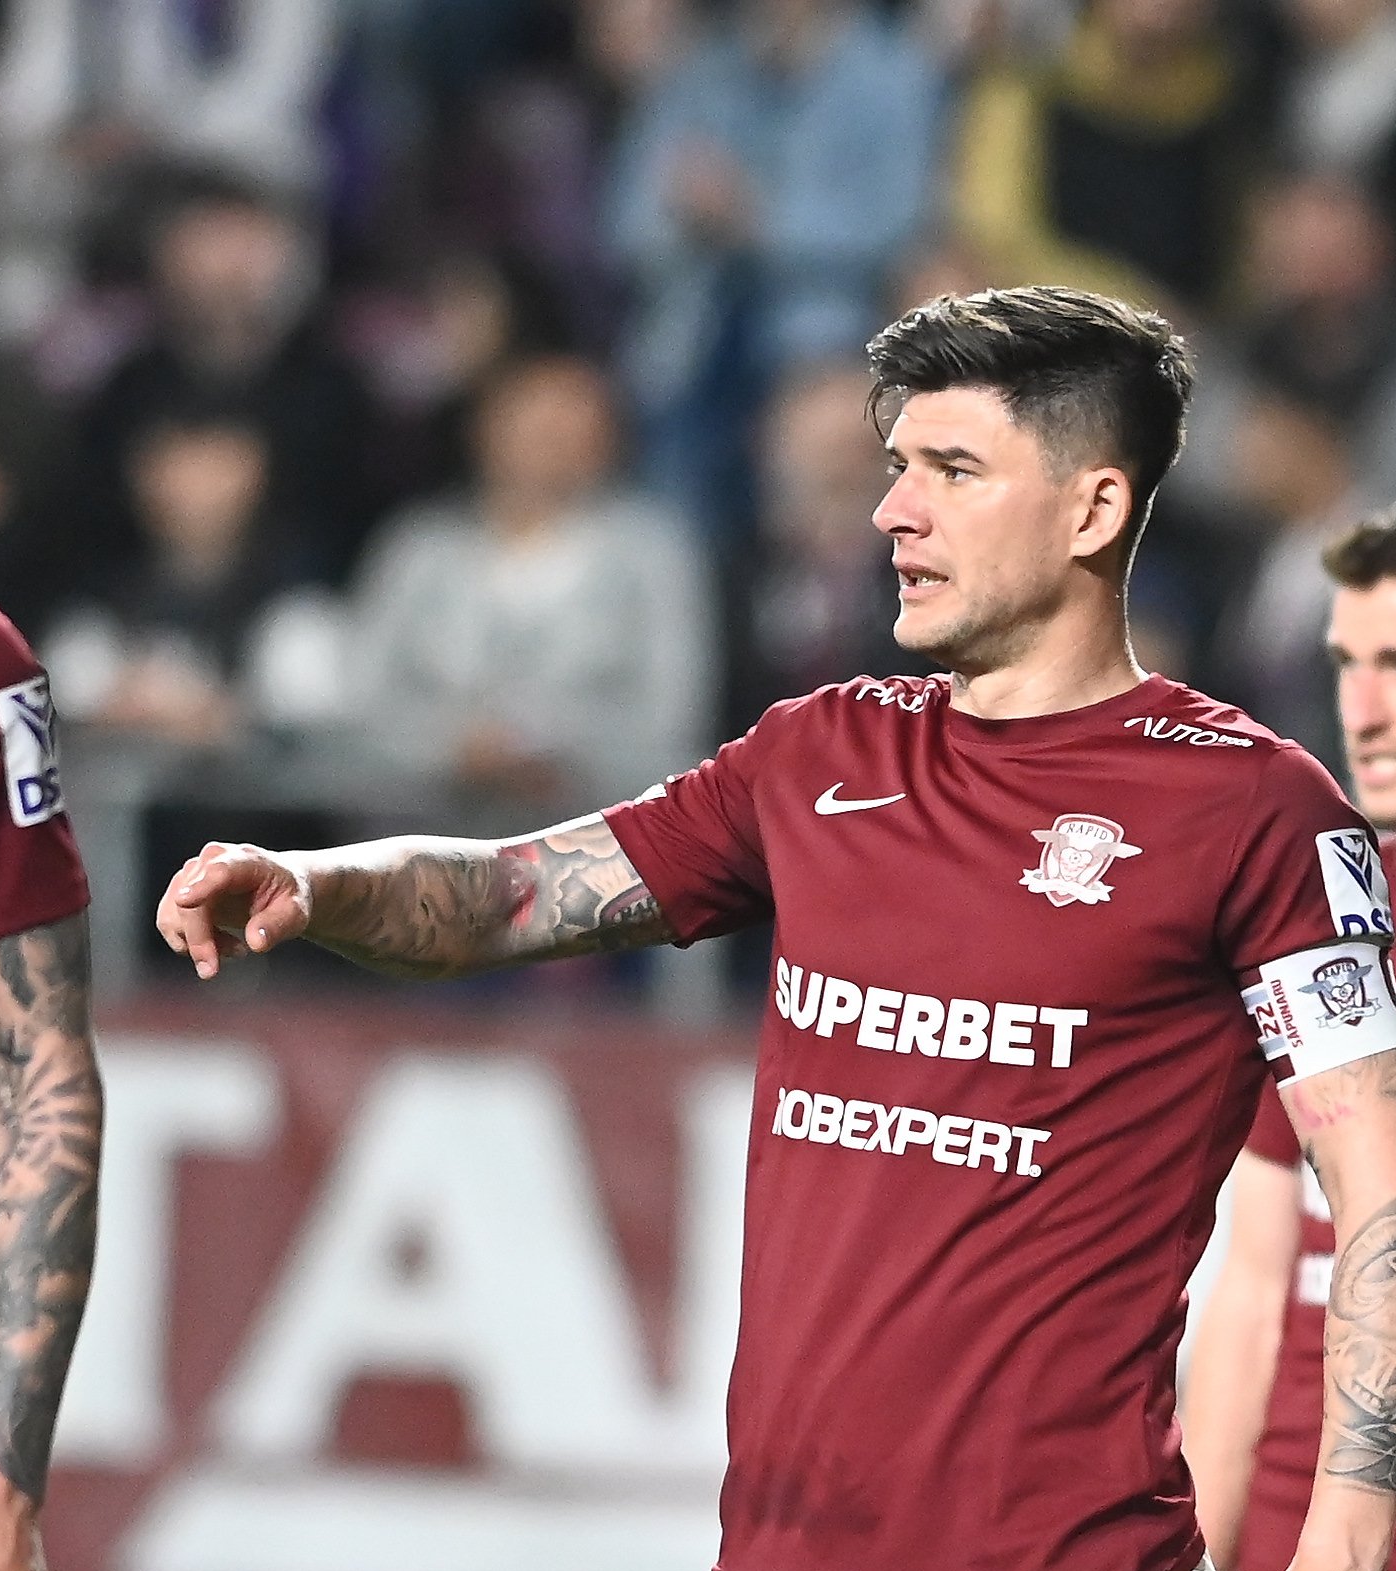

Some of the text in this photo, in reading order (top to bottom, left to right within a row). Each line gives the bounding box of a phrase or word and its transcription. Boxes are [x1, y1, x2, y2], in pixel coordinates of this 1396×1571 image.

[1066, 823, 1108, 841] RAPID
[775, 956, 1089, 1068] SUPERBET
[1255, 1002, 1281, 1038] 22
[1270, 979, 1303, 1048] SAPUNARU
